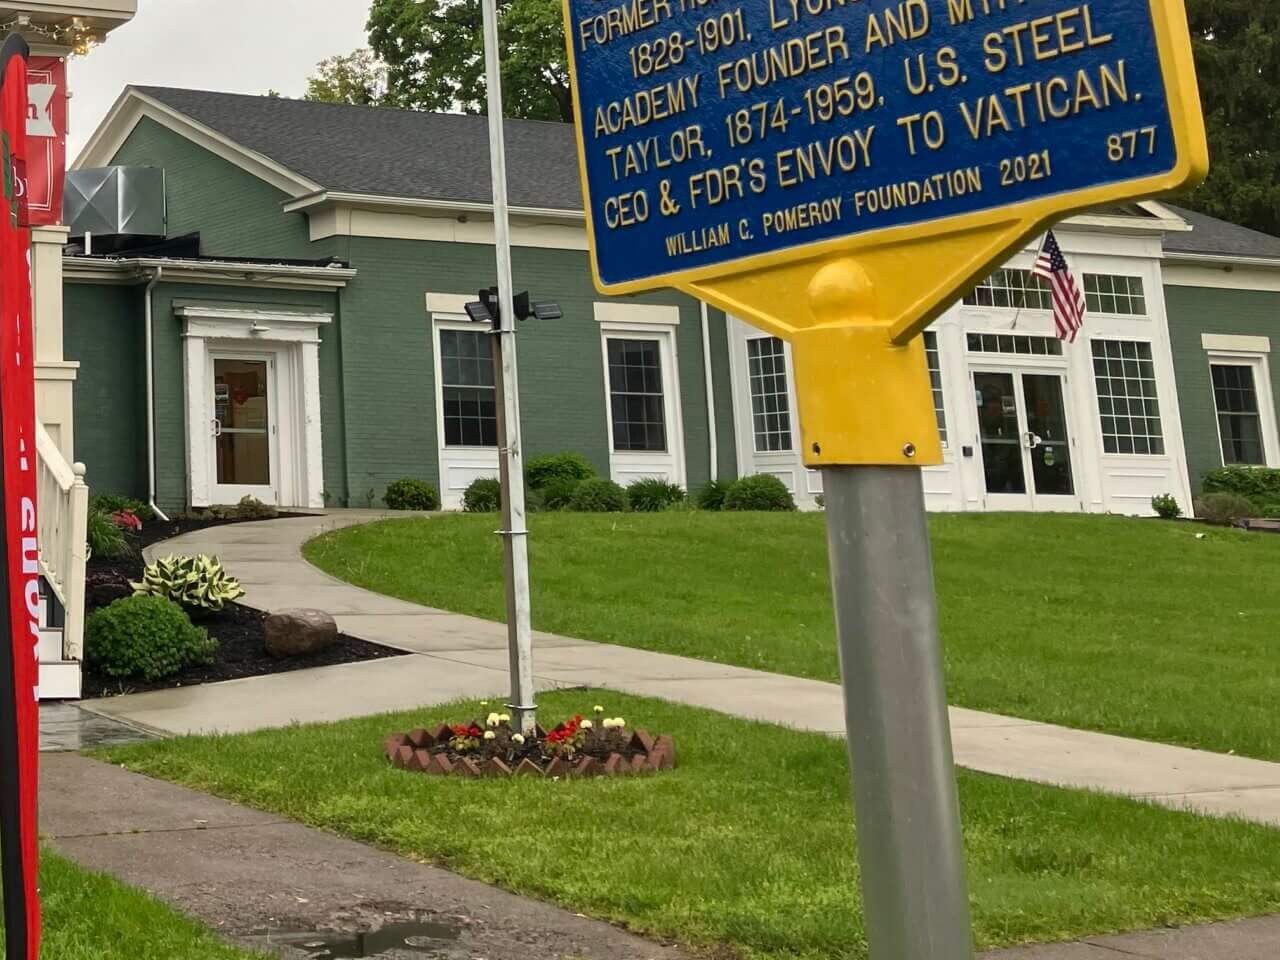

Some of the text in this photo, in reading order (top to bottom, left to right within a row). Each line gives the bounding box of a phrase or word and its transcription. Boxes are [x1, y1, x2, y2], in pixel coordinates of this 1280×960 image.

[595, 75, 699, 137] ACADEMY
[717, 25, 849, 98] FOUNDER
[606, 4, 1113, 177] TAYLOR, 1874-1959, U.S. STEEL
[628, 7, 752, 77] 1828-1901,
[604, 59, 1142, 229] CEO & FDR'S ENVOY TO VATICAN.
[1107, 127, 1155, 161] 877
[665, 223, 730, 257] WILLIAM
[762, 197, 842, 234] POMEROY
[854, 167, 982, 216] FOUNDATION
[999, 149, 1051, 186] 2021
